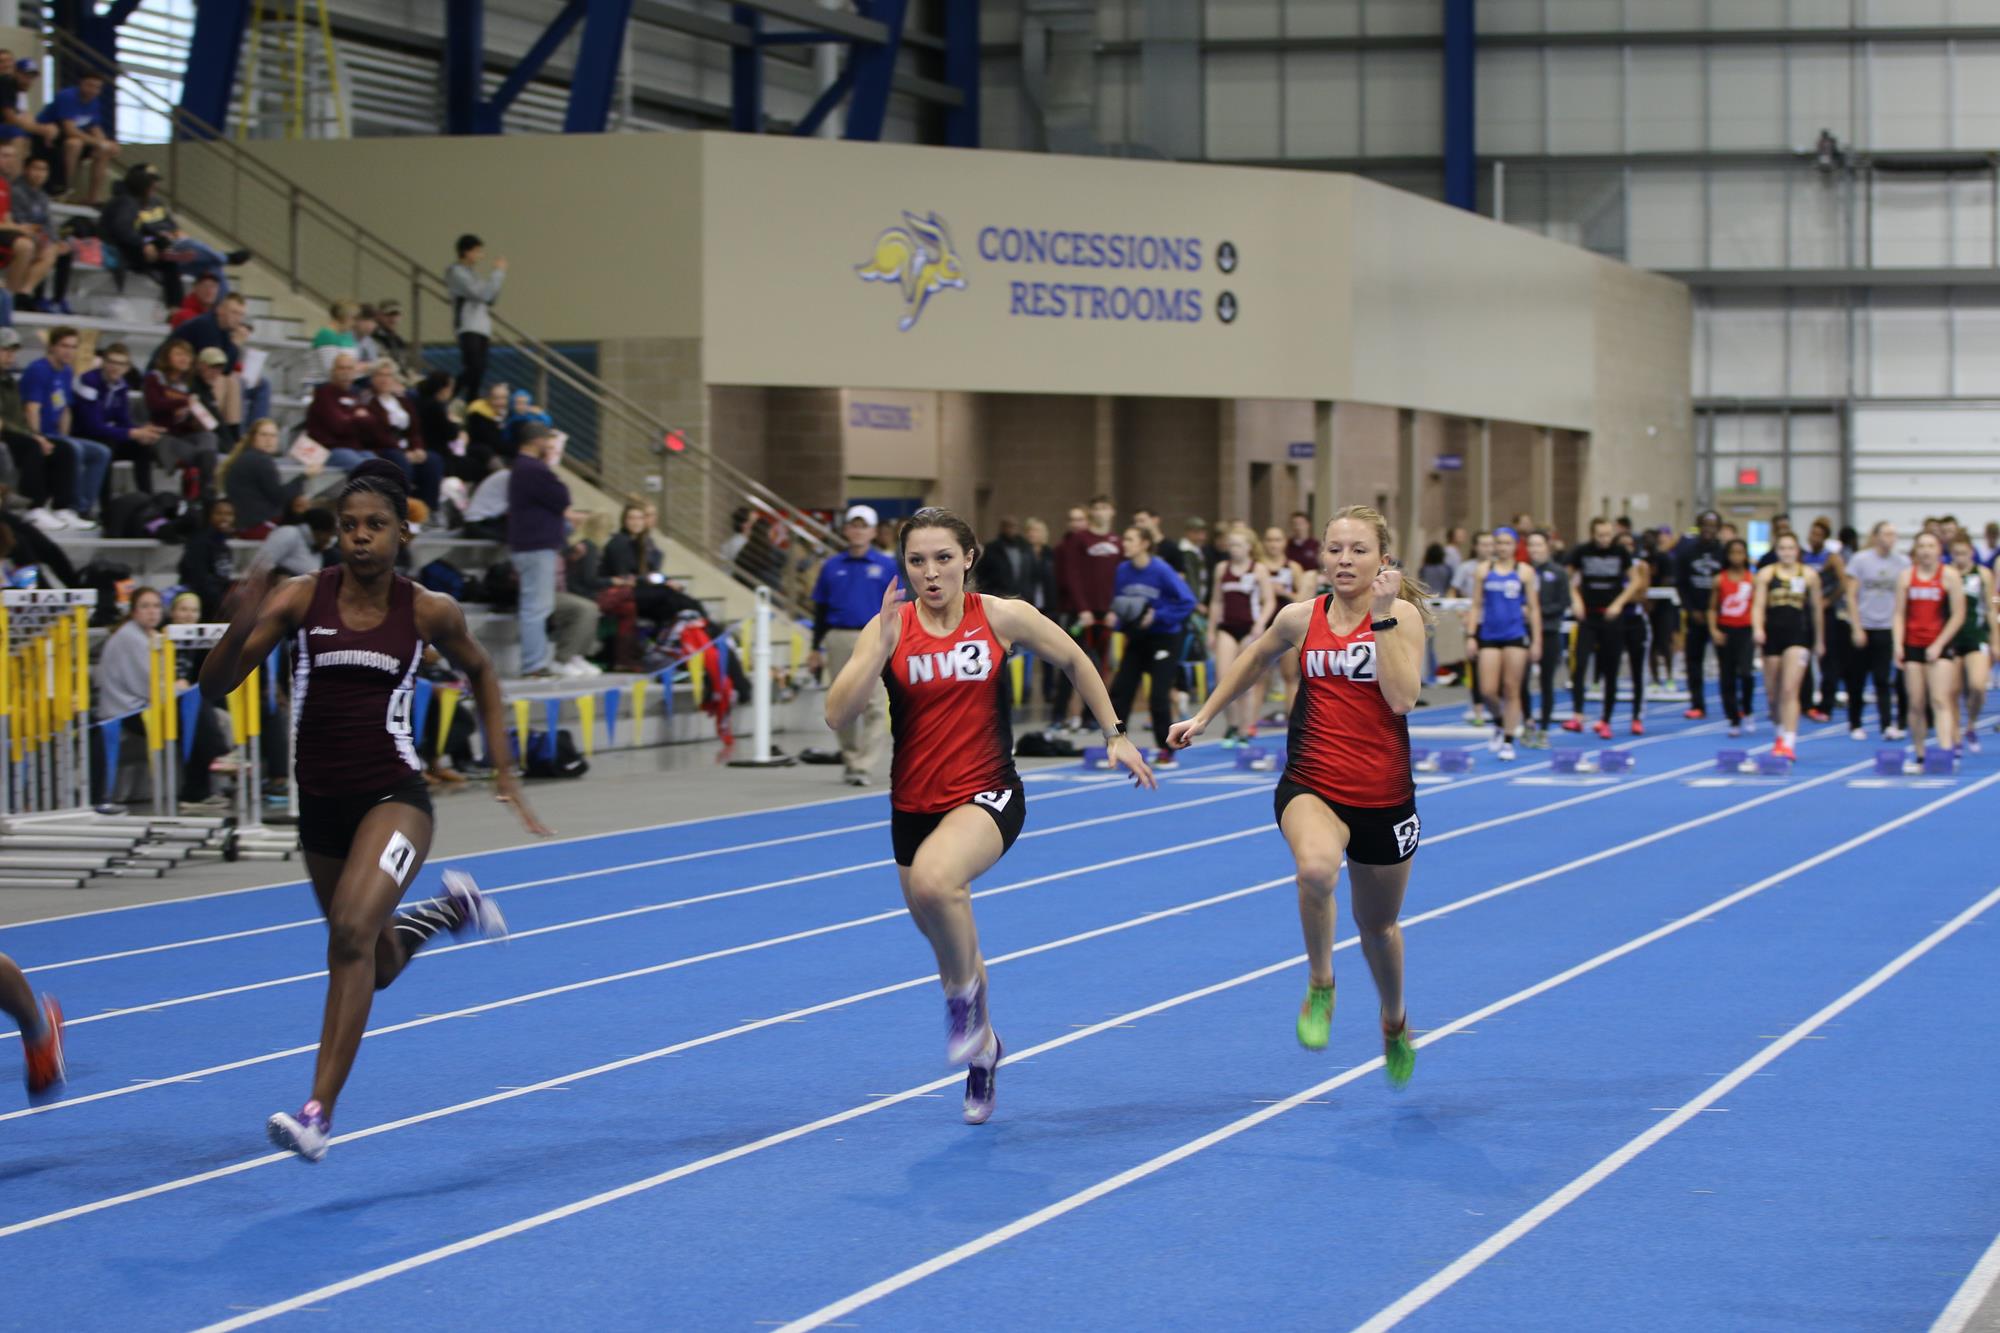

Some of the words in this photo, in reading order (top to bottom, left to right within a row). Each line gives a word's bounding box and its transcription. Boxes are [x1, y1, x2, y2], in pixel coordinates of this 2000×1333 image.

[978, 226, 1202, 272] CONCESSIONS
[1009, 280, 1202, 322] RESTROOMS
[961, 644, 982, 675] 3
[1351, 644, 1373, 679] 2
[1399, 821, 1416, 854] 2
